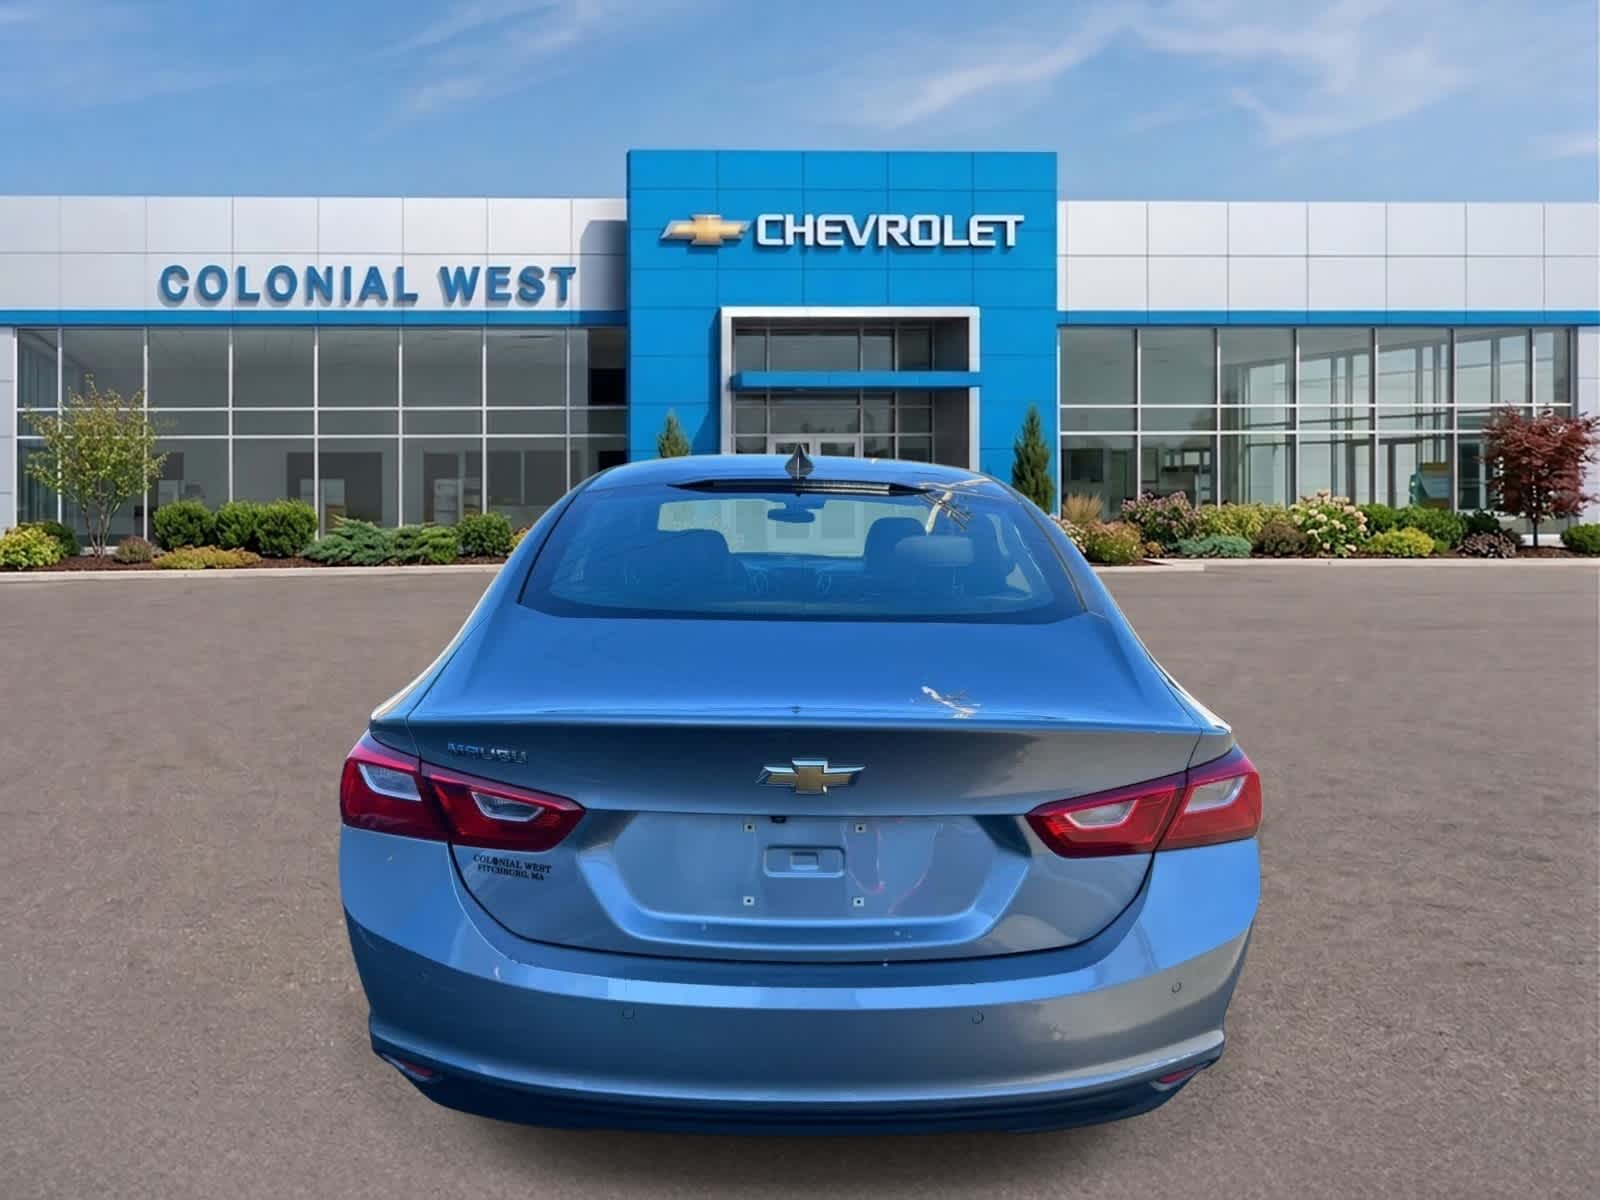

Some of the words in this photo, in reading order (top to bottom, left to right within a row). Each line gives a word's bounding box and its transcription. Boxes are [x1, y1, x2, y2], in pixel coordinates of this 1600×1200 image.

[756, 214, 1025, 247] CHEVROLET
[160, 265, 418, 304] COLONIAL
[438, 265, 577, 303] WEST
[473, 855, 523, 870] COLONIAL
[525, 862, 552, 874] WEST
[530, 871, 545, 881] MA
